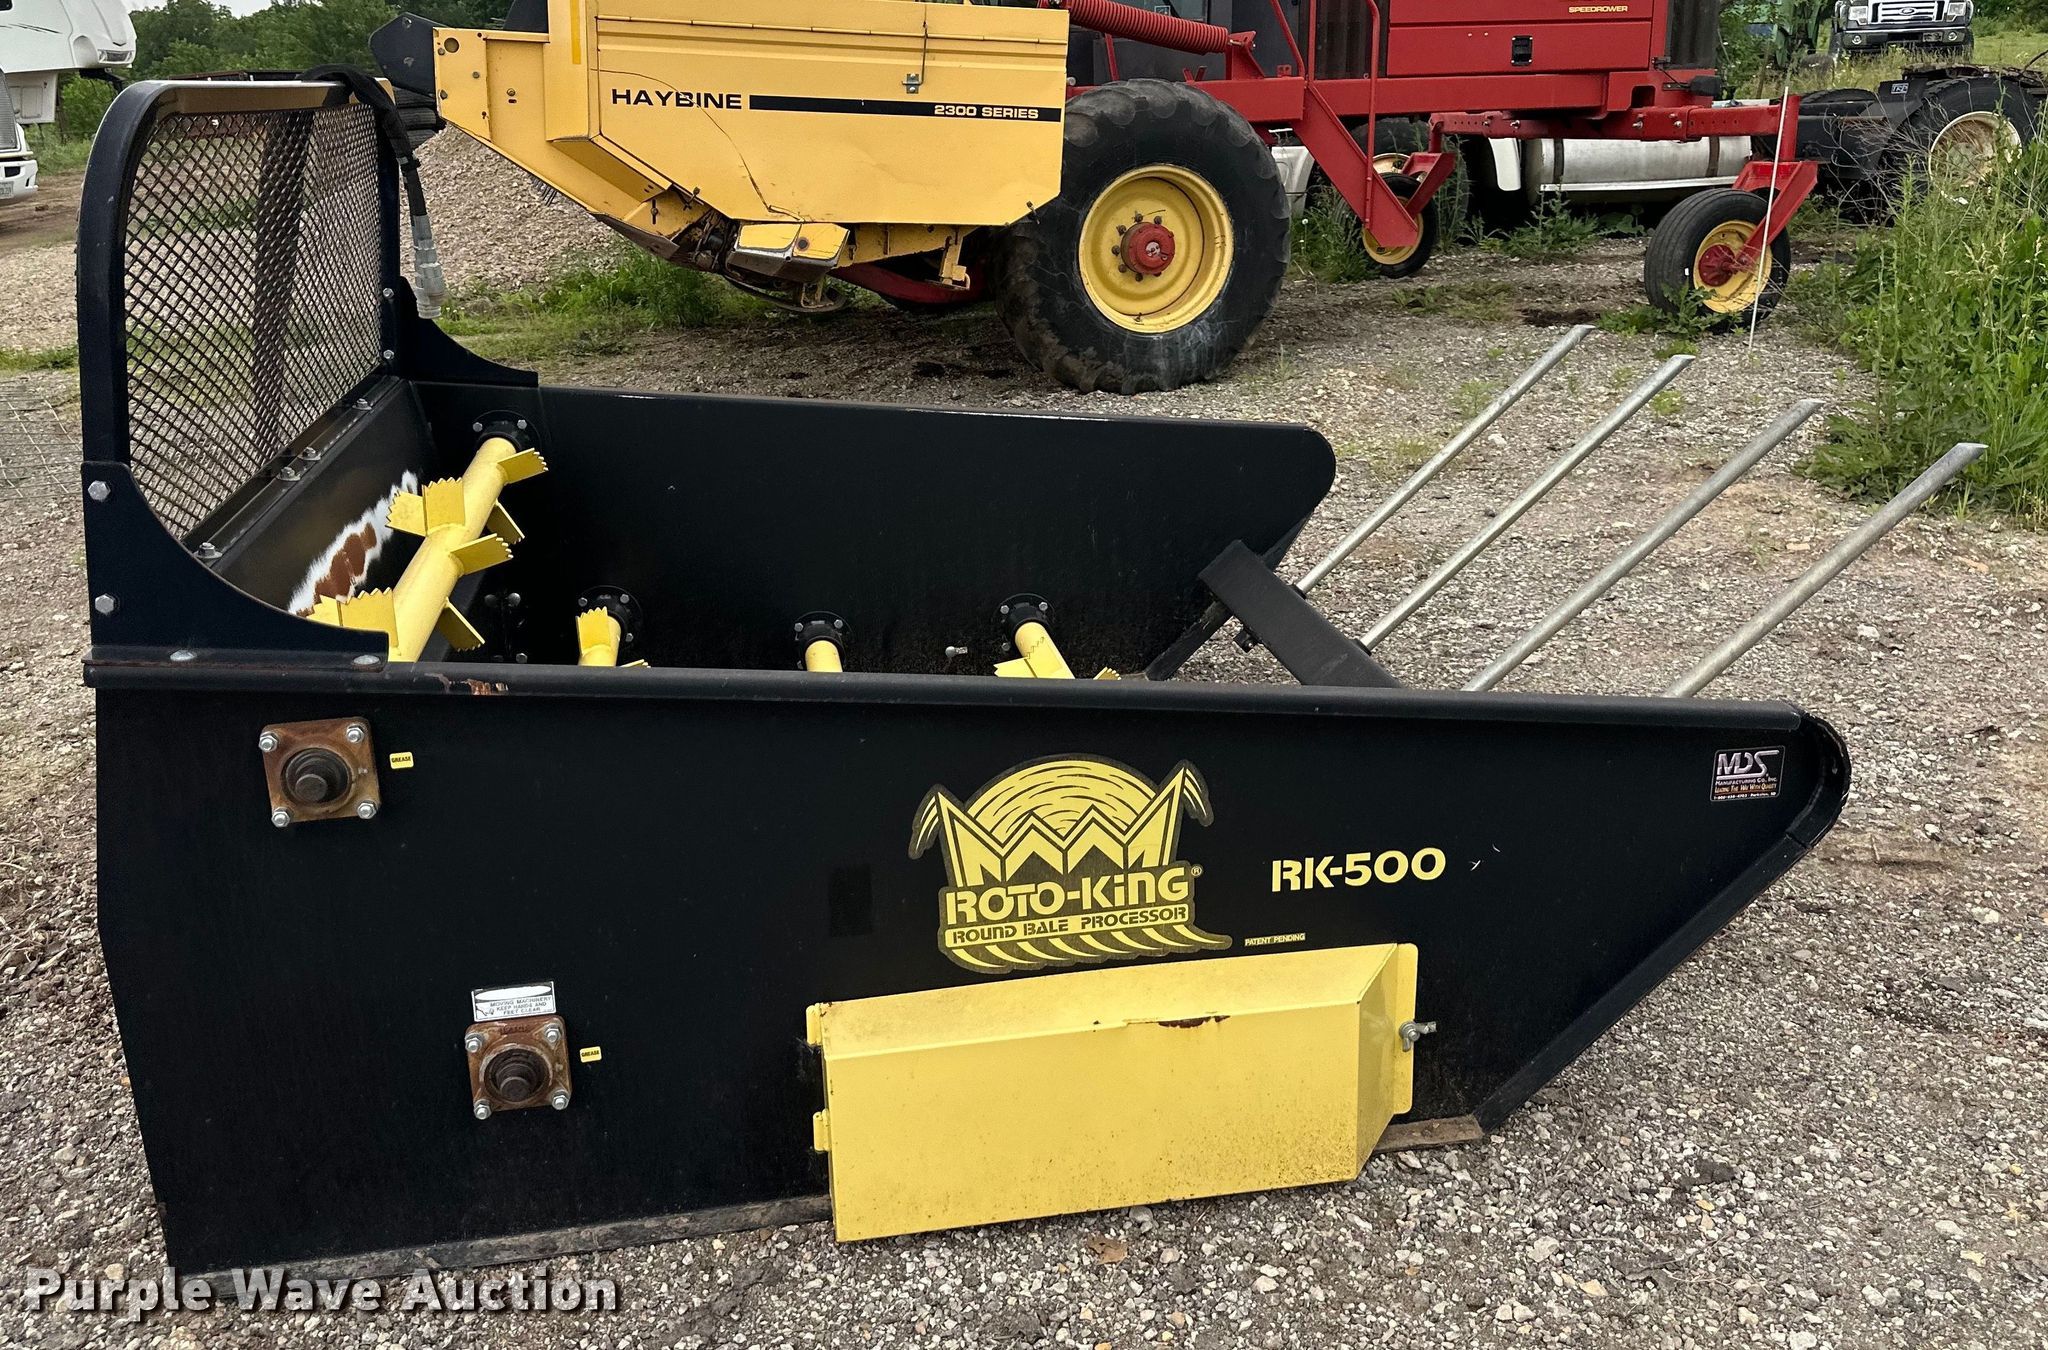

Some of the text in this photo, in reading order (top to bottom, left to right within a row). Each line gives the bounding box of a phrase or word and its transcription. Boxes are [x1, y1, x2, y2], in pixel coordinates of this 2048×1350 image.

[1568, 5, 1628, 13] SPEEDROWER
[611, 88, 1039, 119] HAYBINE 2300 SERIES
[1271, 847, 1446, 893] RK-500
[1023, 919, 1069, 936] BALE
[1081, 906, 1187, 929] PROCESSOR
[1245, 932, 1306, 947] PATENT PENDING
